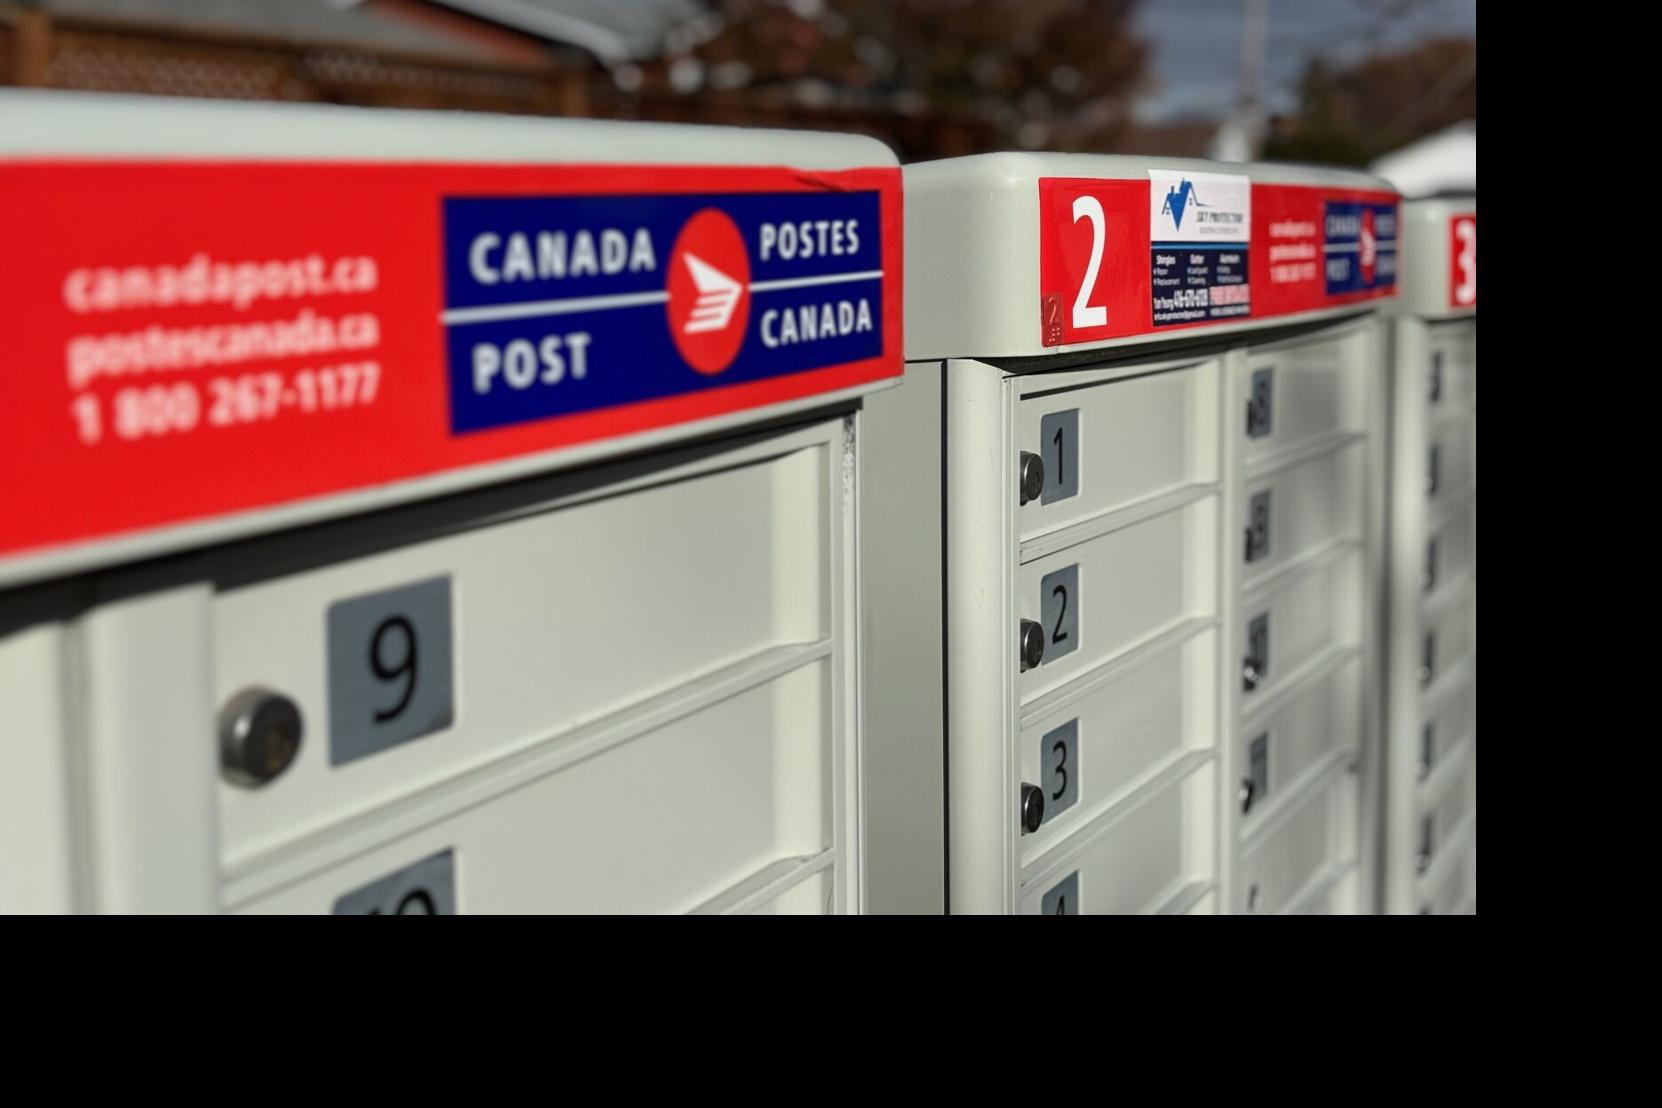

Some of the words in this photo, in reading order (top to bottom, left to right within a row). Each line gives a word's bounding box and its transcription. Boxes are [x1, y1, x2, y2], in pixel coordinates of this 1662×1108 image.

[469, 228, 656, 285] CANADA
[759, 219, 860, 261] POSTES
[1073, 195, 1107, 328] 2
[64, 252, 377, 311] canadapost.ca
[67, 309, 380, 388] postescanada.ca
[760, 298, 873, 348] CANADA
[472, 332, 591, 394] POST
[73, 394, 101, 443] 1
[114, 382, 199, 439] 800
[207, 361, 381, 427] 267-1177
[1053, 427, 1063, 485] 1
[1052, 584, 1068, 645] 2
[367, 613, 419, 725] 9
[1052, 740, 1068, 801] 3
